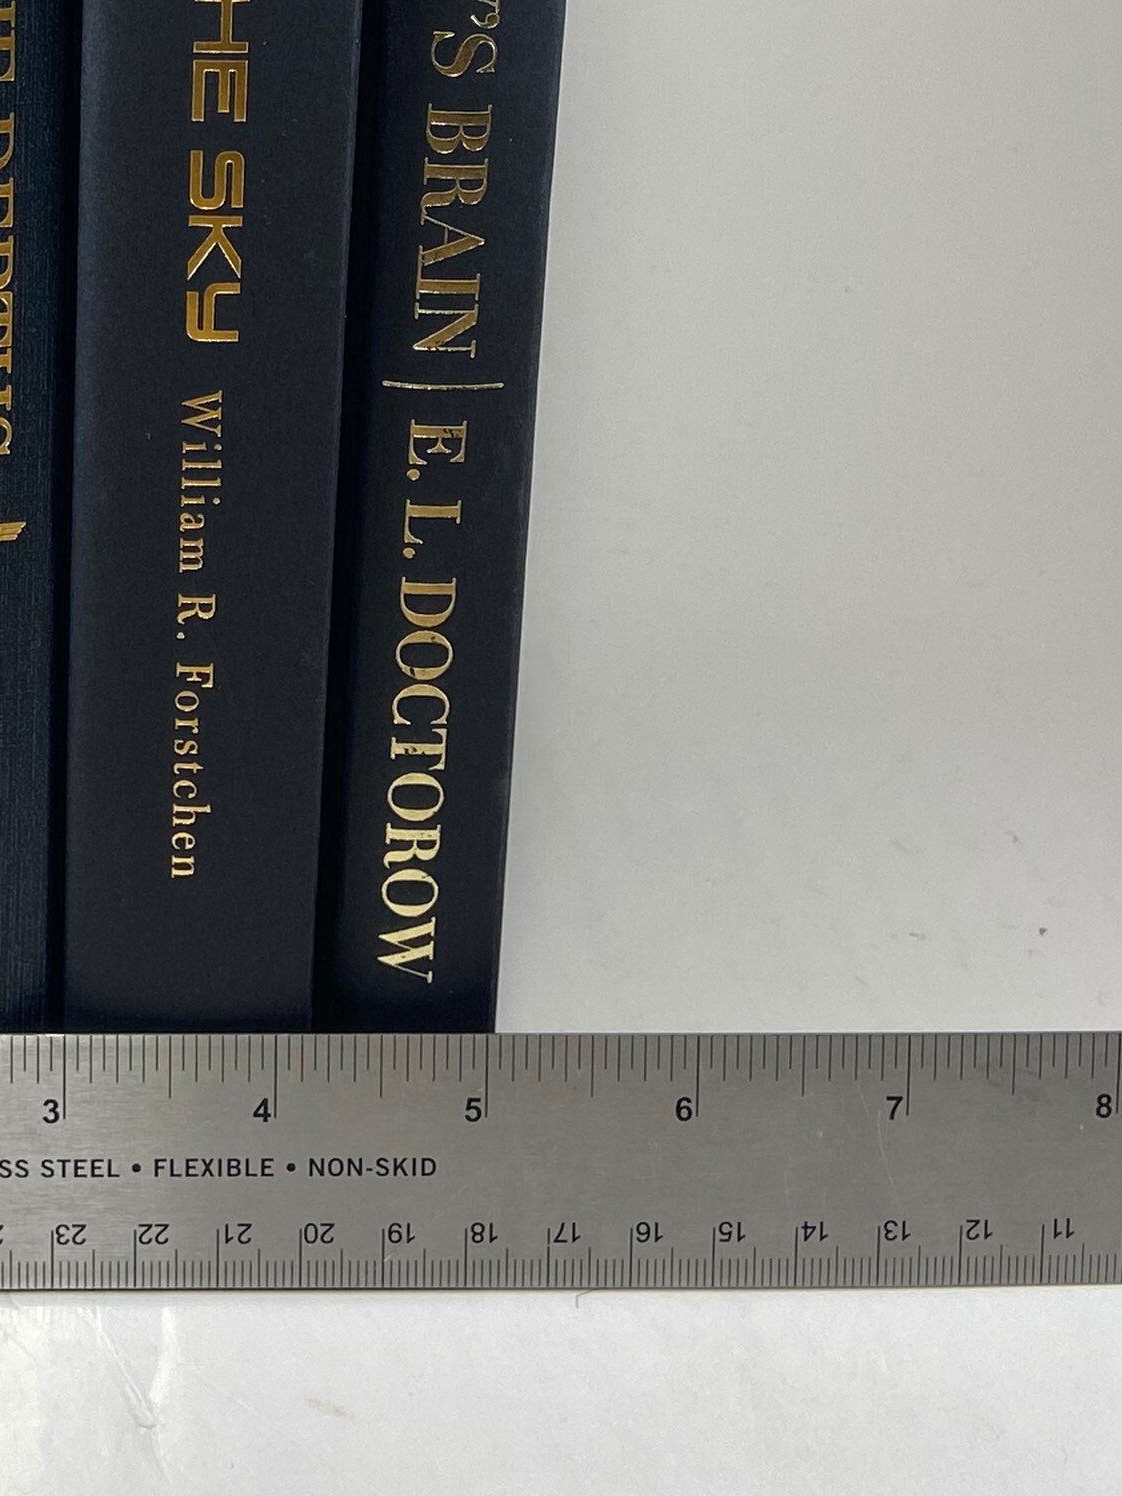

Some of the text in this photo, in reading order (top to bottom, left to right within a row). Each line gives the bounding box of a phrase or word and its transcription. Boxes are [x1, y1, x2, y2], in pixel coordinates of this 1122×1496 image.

[412, 102, 493, 359] BRAIN
[185, 149, 245, 343] SKY
[169, 389, 223, 879] William R. Forstchen
[376, 418, 468, 984] E. L. DOCTOROW
[42, 1098, 60, 1124] 3
[252, 1097, 272, 1123] 4
[464, 1097, 482, 1123] 5
[675, 1096, 693, 1122] 6
[886, 1095, 904, 1121] 7
[1095, 1093, 1113, 1119] 8
[40, 1158, 121, 1178] STEEL
[154, 1157, 275, 1178] FLEXIBLE
[309, 1157, 437, 1177] NON-SKID
[55, 1223, 87, 1246] 23
[138, 1223, 170, 1245] 22
[224, 1223, 253, 1245] 21
[303, 1222, 335, 1244] 20
[387, 1222, 416, 1244] 19
[470, 1222, 499, 1244] 18
[553, 1221, 581, 1244] 17
[635, 1221, 664, 1243] 16
[718, 1221, 746, 1243] 15
[800, 1220, 829, 1242] 14
[883, 1219, 911, 1242] 13
[965, 1219, 993, 1241] 12
[1053, 1217, 1075, 1239] 11
